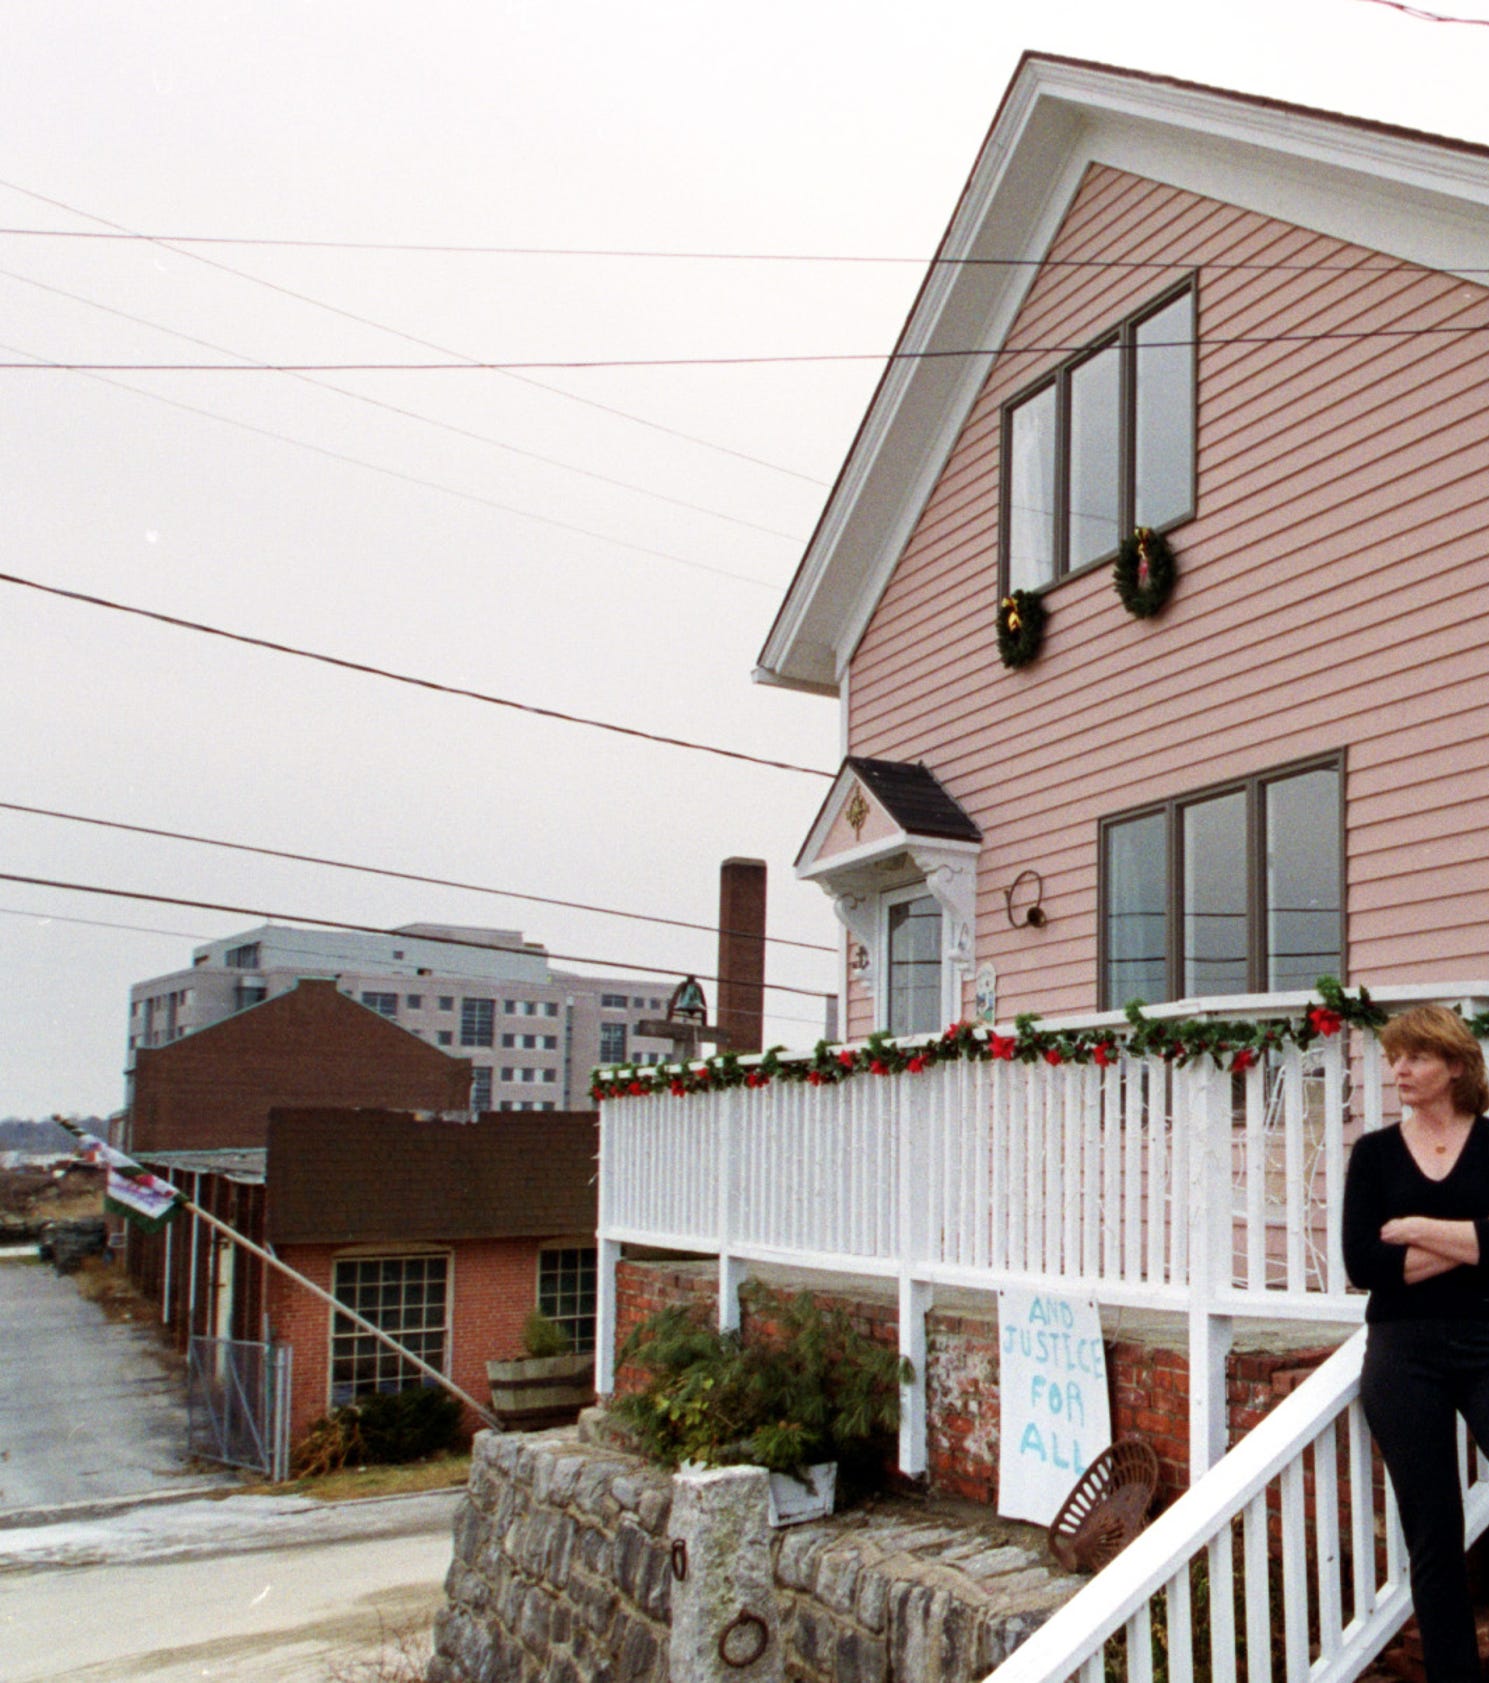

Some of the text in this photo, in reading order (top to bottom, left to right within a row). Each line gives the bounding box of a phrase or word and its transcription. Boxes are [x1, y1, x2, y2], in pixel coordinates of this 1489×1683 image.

[1029, 1296, 1074, 1329] AND
[1003, 1324, 1103, 1379] JUSTICE
[1031, 1374, 1085, 1428] FOR
[1020, 1423, 1087, 1476] ALL
